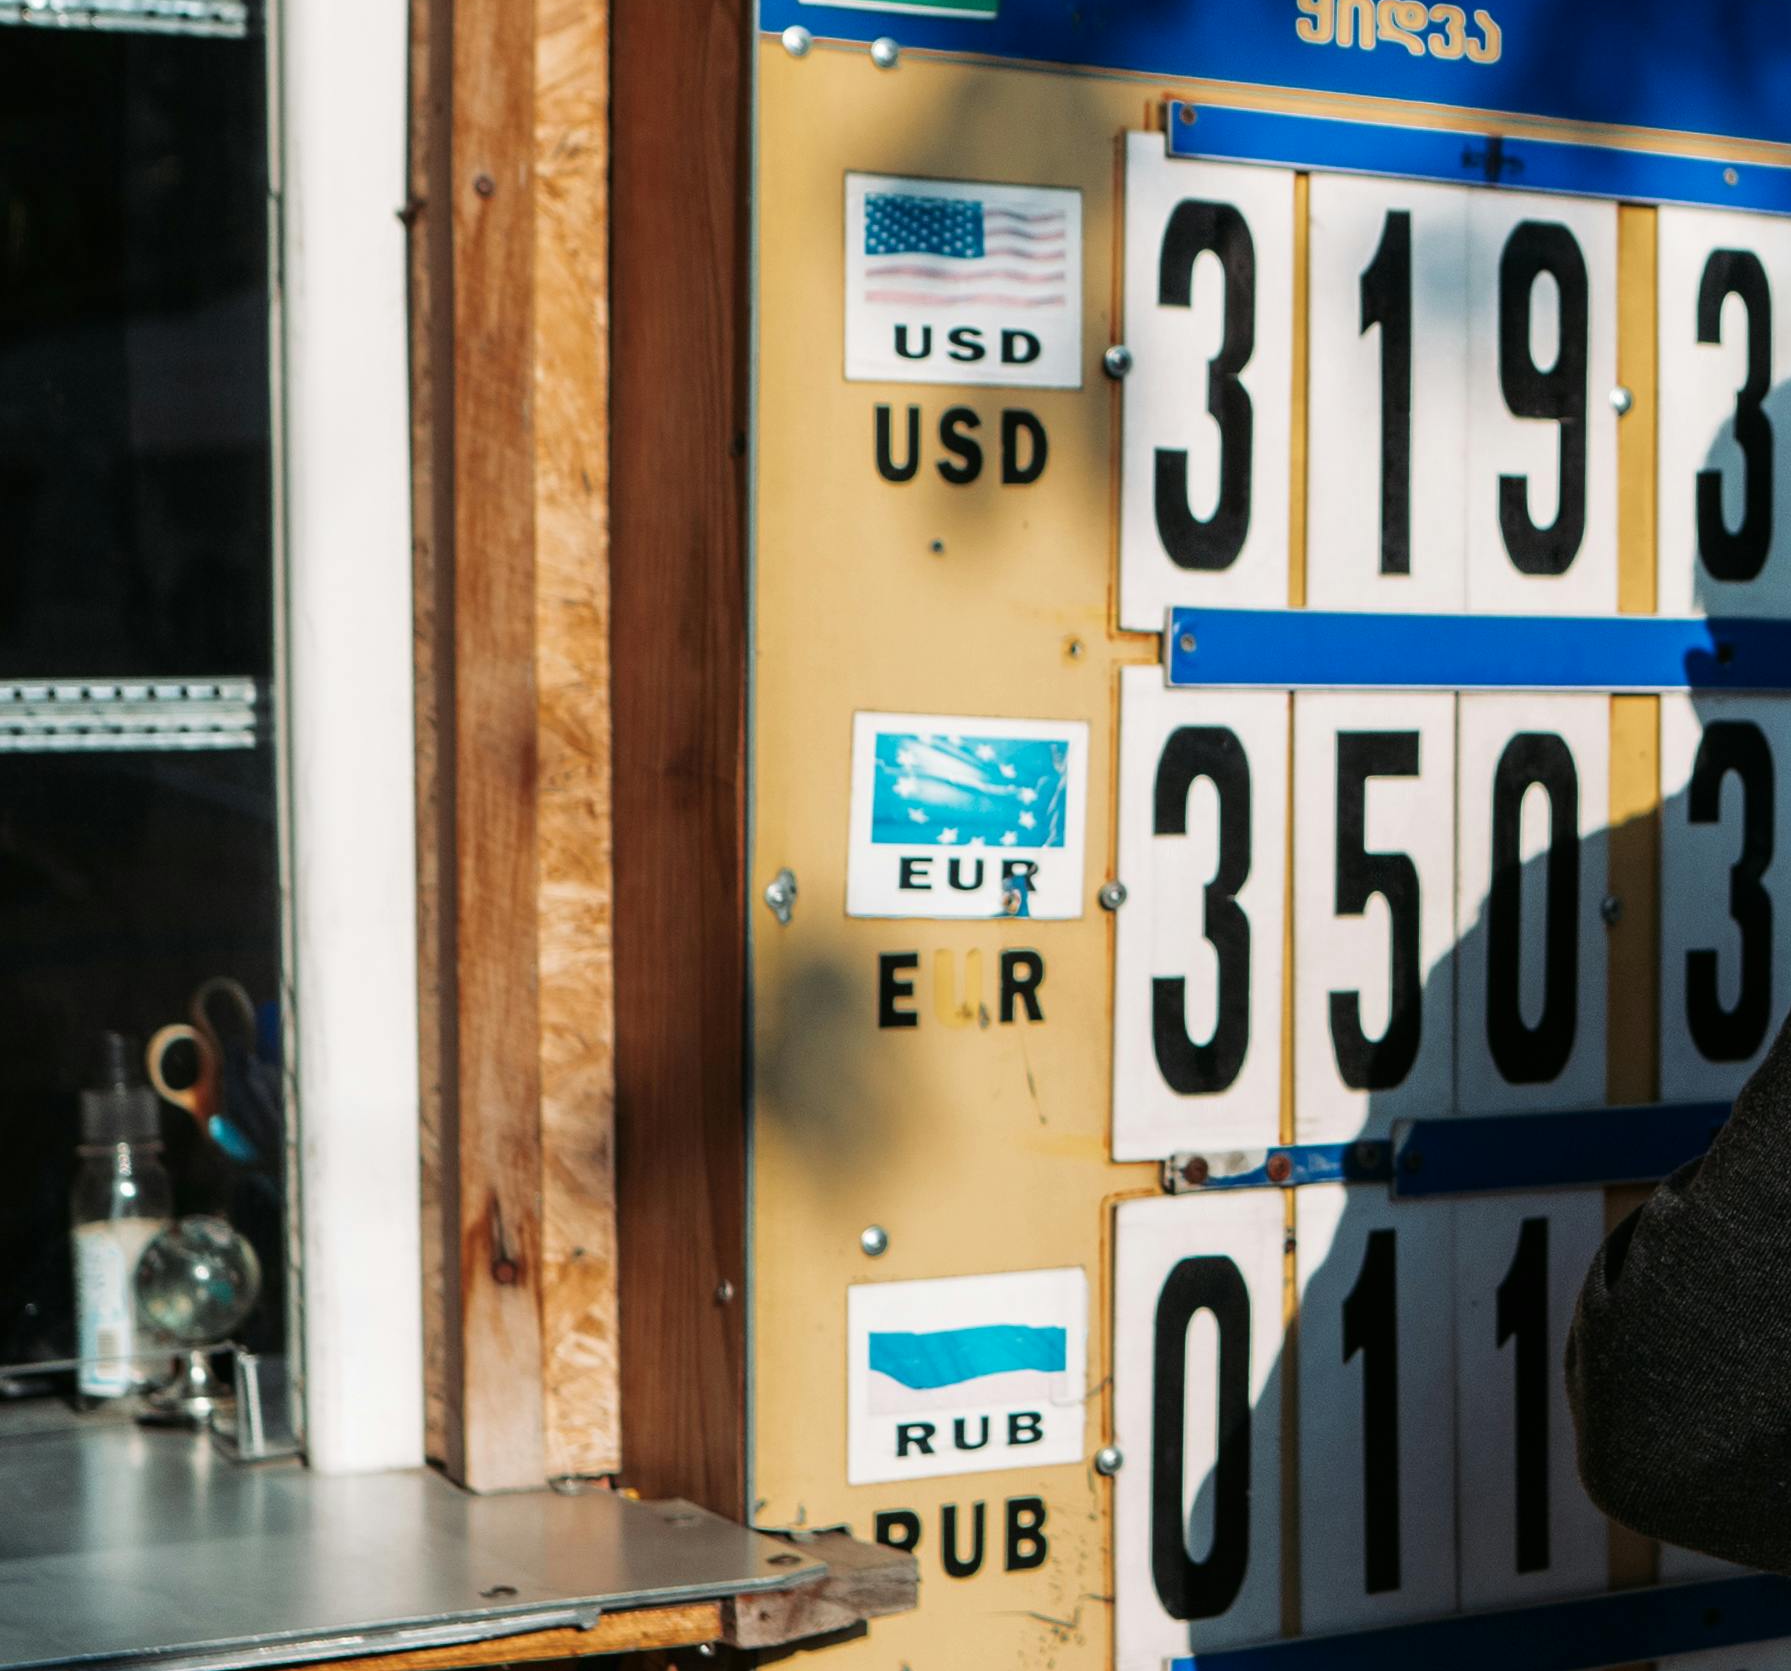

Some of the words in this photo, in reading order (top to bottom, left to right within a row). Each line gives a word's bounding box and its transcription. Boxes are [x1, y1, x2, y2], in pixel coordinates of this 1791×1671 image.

[893, 324, 1042, 365] USD
[874, 404, 1050, 485] USD
[898, 855, 1040, 892] EUR
[895, 1411, 1045, 1458] RUB
